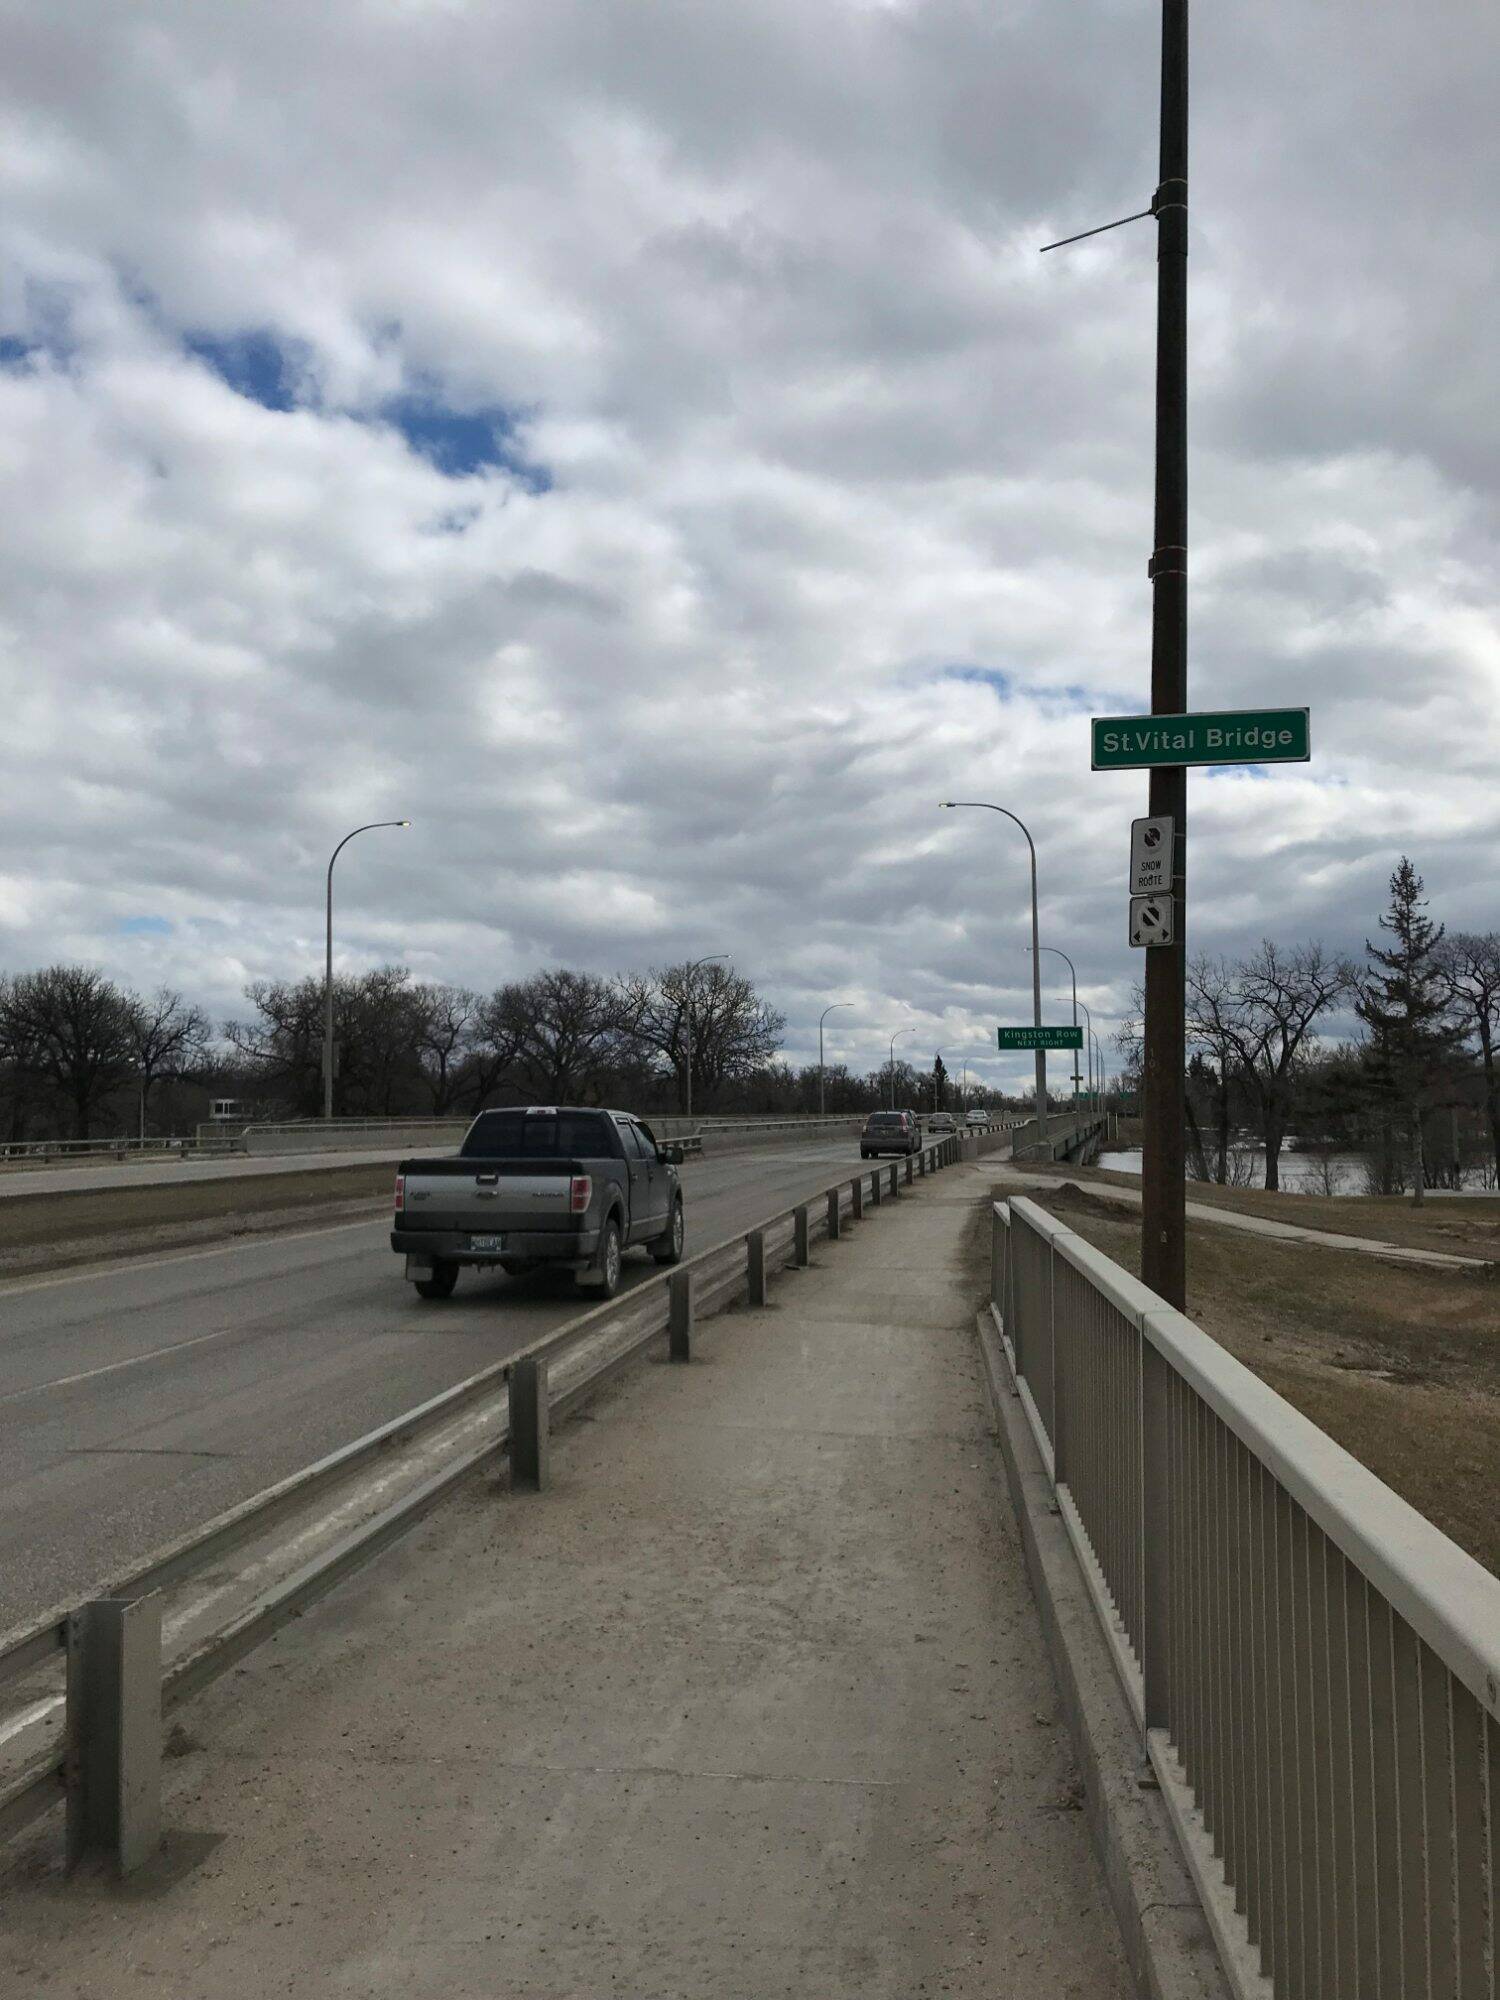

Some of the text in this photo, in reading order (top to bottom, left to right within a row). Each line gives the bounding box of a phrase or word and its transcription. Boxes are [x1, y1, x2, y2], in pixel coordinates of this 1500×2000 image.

[1206, 727, 1293, 749] Bridge
[1141, 860, 1162, 871] SNOW
[1138, 875, 1163, 887] ROUTE
[1004, 1030, 1078, 1039] Kingston Row
